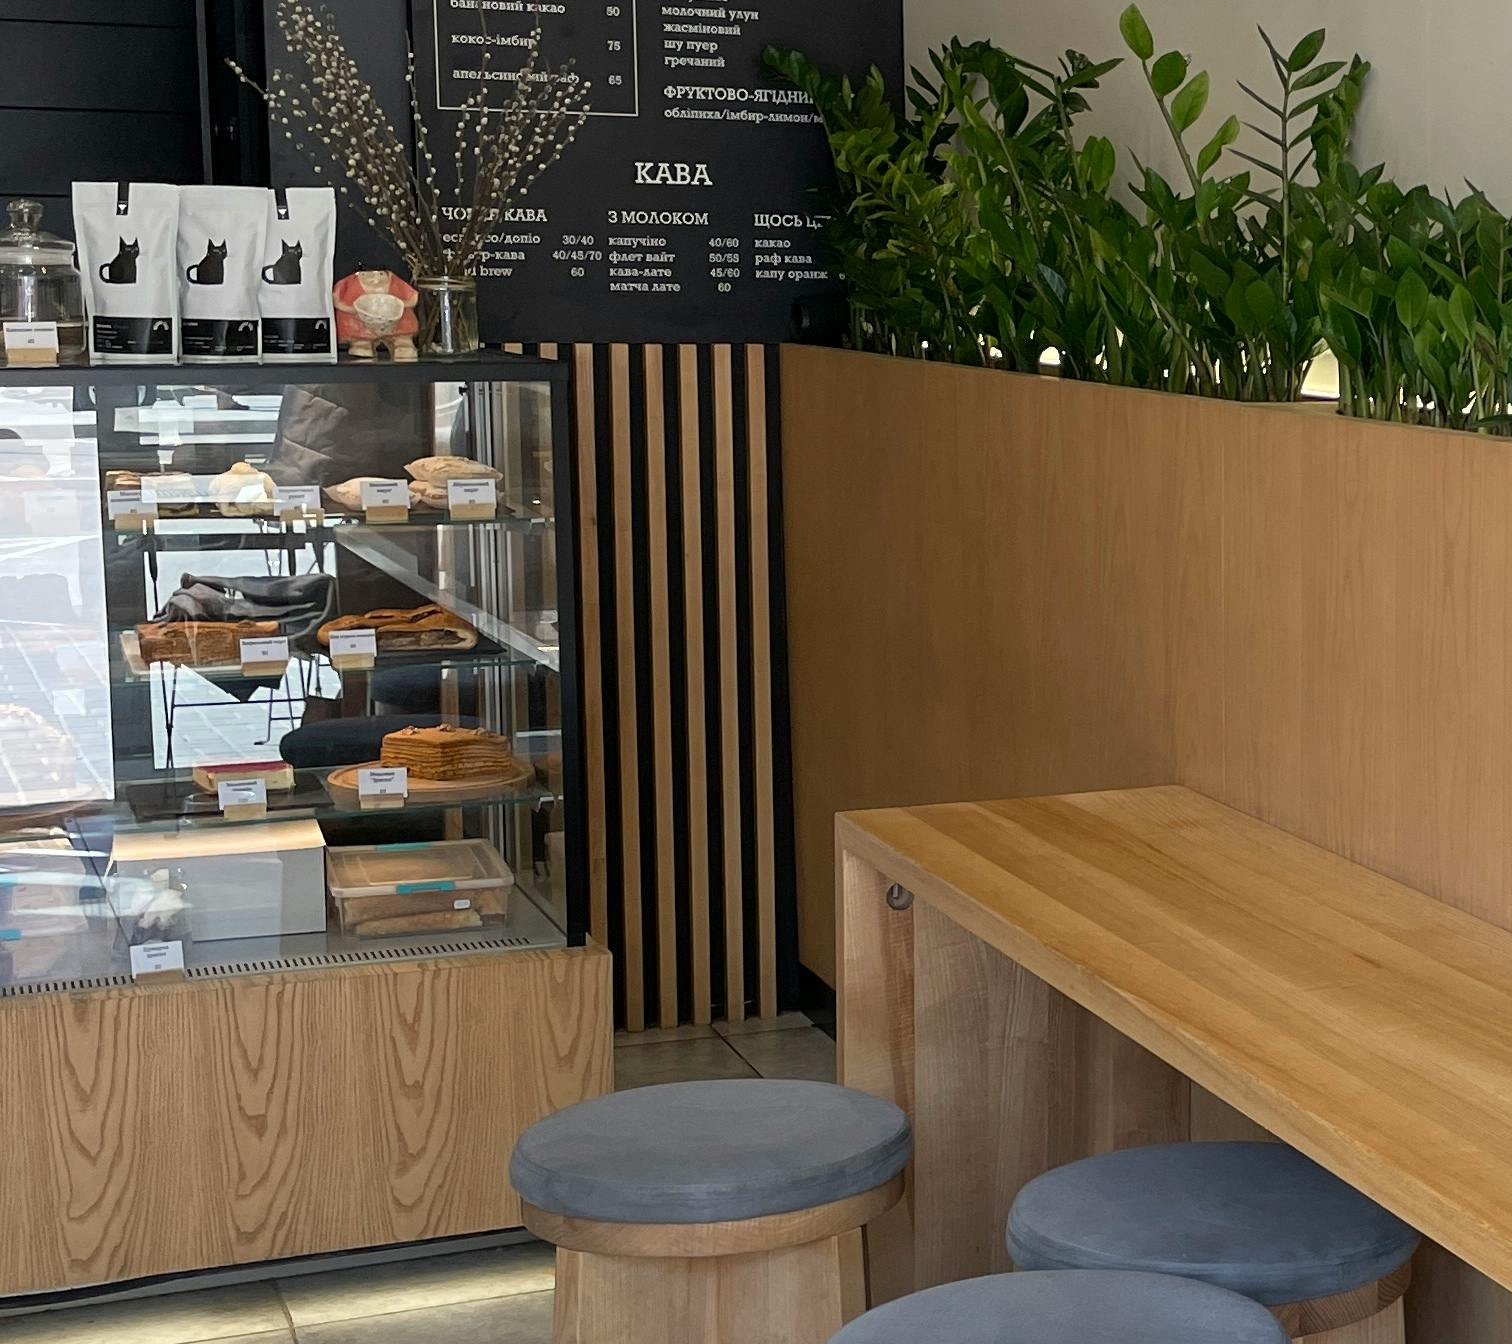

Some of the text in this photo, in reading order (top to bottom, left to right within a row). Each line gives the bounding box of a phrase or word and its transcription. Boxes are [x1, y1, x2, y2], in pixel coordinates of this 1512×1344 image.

[607, 7, 620, 16] 50
[662, 7, 758, 22] молочний улун
[663, 23, 740, 35] жасміновий
[608, 41, 620, 50] 75
[664, 40, 718, 53] шу пуер
[665, 57, 725, 67] гречаний
[609, 75, 622, 85] 65
[664, 85, 814, 104] ФРУКТОВО-ЯГІДНИ
[635, 162, 712, 185] КАВА
[505, 208, 547, 222] КАВА
[608, 211, 708, 224] З МОЛОКОМ
[754, 214, 802, 229] ЩОСЬ
[563, 235, 594, 245] 30/40
[609, 236, 739, 248] капучіно 40/60
[755, 240, 791, 248] какао
[553, 250, 602, 260] 40/45/70
[609, 251, 643, 264] флет
[646, 252, 675, 262] вайт
[755, 253, 781, 265] раф
[480, 265, 512, 276] brew
[571, 267, 584, 276] 60
[610, 268, 740, 277] кава-лате 45/60
[756, 270, 785, 281] капу
[788, 271, 828, 281] оранж
[610, 283, 731, 292] матча лате 60
